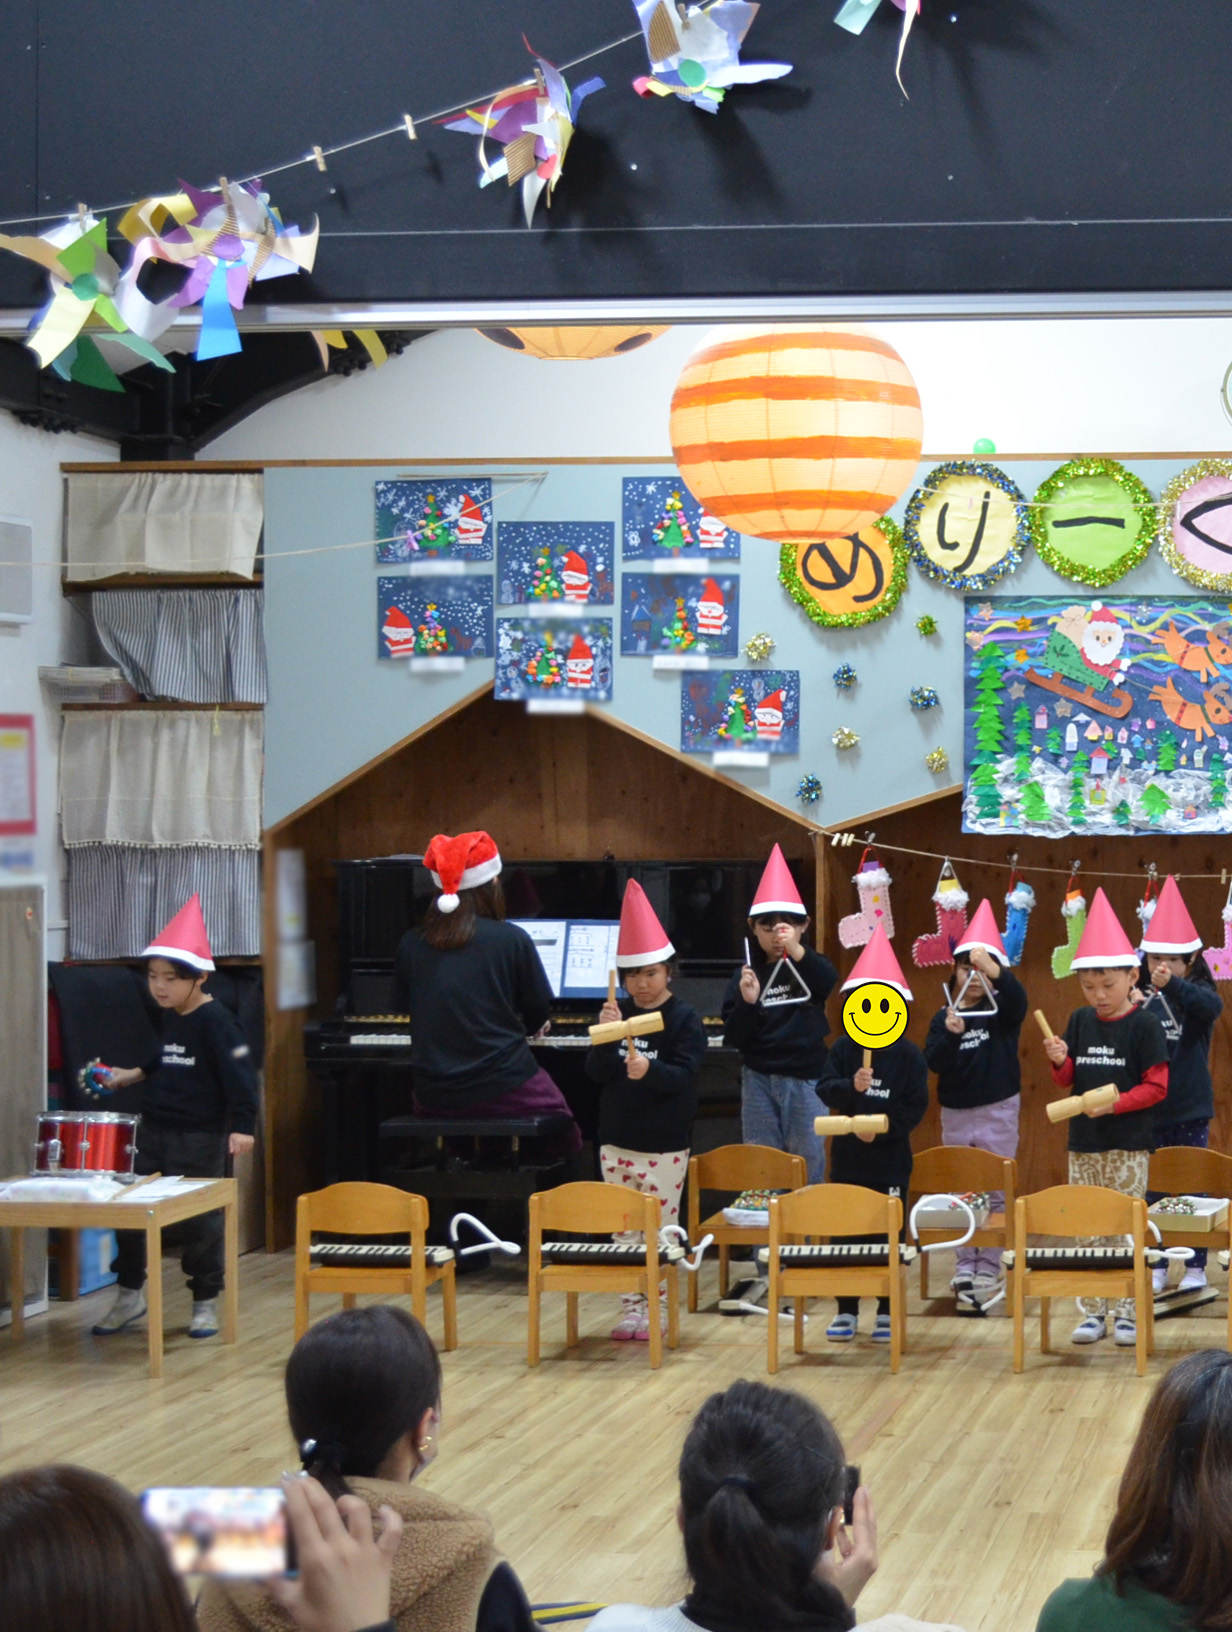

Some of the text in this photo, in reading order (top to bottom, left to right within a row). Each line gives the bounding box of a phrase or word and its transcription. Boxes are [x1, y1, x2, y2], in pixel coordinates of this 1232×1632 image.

[621, 1037, 649, 1049] mku
[1087, 1045, 1115, 1055] moku
[1076, 1055, 1126, 1067] preschool
